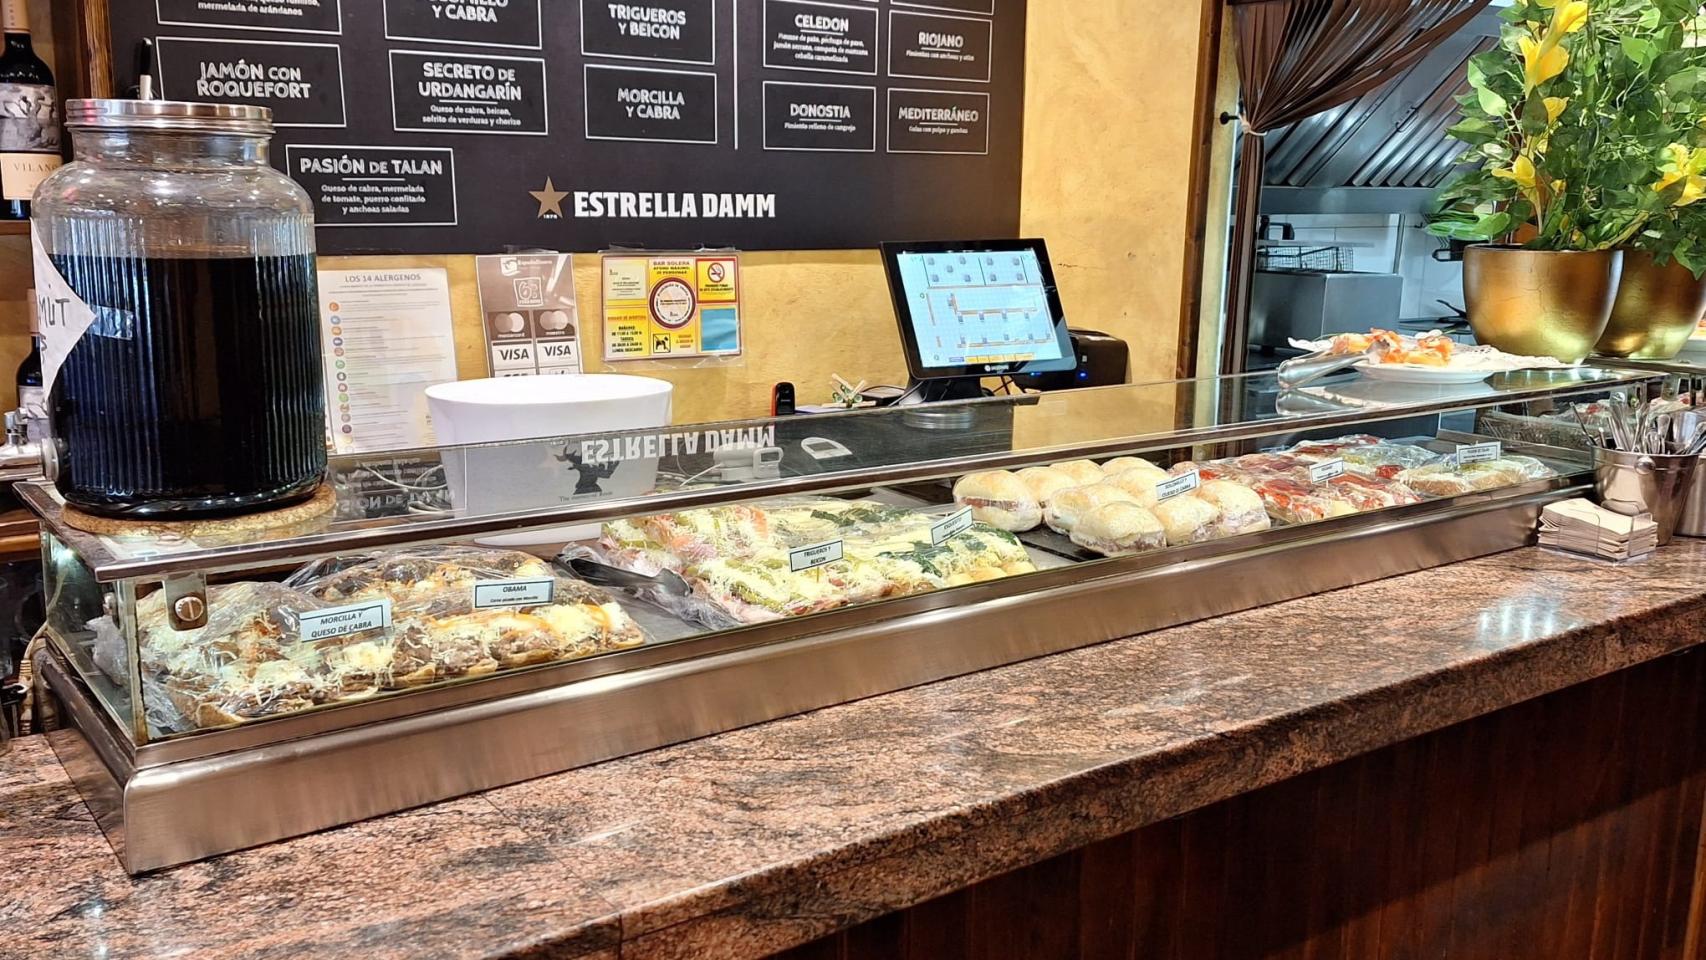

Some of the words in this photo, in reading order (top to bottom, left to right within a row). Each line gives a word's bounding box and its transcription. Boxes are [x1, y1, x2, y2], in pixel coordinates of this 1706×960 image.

[198, 2, 247, 12] mermelada
[248, 4, 258, 13] de
[432, 5, 442, 18] Y
[445, 4, 498, 22] CABRA
[608, 3, 687, 25] TRIGUEROS
[618, 22, 627, 35] Y
[629, 21, 680, 40] BEICON
[794, 14, 849, 32] CELEDON
[918, 31, 964, 48] RIOJANO
[200, 58, 264, 80] JAMÓN
[268, 66, 302, 81] CON
[423, 62, 494, 80] SECRETO
[498, 68, 516, 82] DE
[196, 79, 311, 98] ROQUEFORT
[418, 81, 522, 101] URDANGARÍN
[617, 87, 685, 106] MORCILLA
[430, 104, 453, 113] Queso
[455, 105, 464, 114] de
[465, 106, 486, 115] cabra,
[625, 105, 634, 118] Y
[636, 104, 681, 120] CABRA
[790, 103, 851, 119] DONOSTIA
[898, 105, 979, 122] MEDITERRÁNEO
[448, 115, 457, 124] de
[458, 115, 489, 125] verduras
[489, 118, 495, 127] y
[300, 154, 365, 174] PASIÓN
[369, 161, 388, 174] DE
[391, 159, 443, 175] TALAN
[321, 184, 346, 192] Queso
[347, 184, 357, 192] de
[359, 184, 381, 193] cabra,
[382, 184, 424, 193] mermelada
[321, 194, 331, 202] de
[332, 195, 363, 203] tomate,
[363, 195, 390, 204] puerro
[573, 190, 698, 218] ESTRELLA
[702, 193, 776, 218] DAMM
[342, 206, 348, 215] y
[349, 204, 380, 213] anchoas
[345, 275, 360, 283] LOS
[500, 348, 530, 361] VISA
[544, 345, 571, 357] VISA
[320, 612, 357, 625] MORCILLA
[311, 627, 337, 638] QUESO
[338, 625, 347, 633] DE
[348, 620, 372, 631] CABRA
